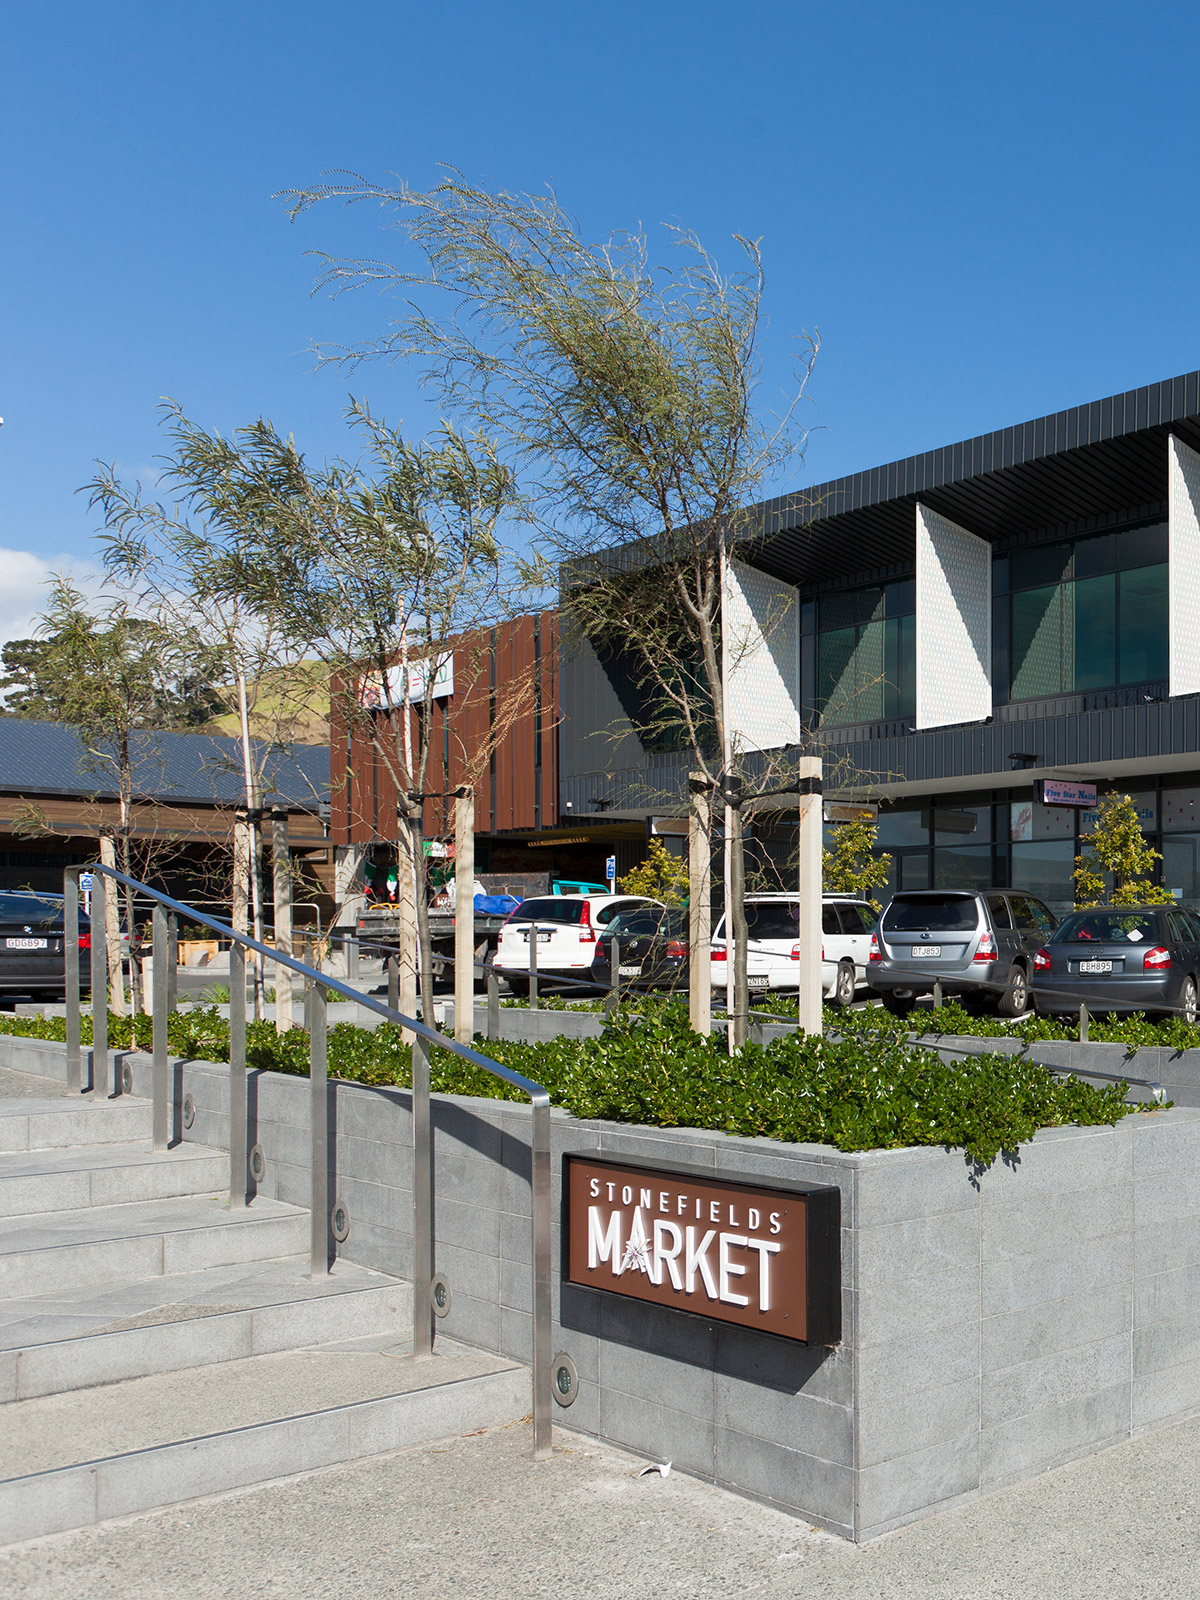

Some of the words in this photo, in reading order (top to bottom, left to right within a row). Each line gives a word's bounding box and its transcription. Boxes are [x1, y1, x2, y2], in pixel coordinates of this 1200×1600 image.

[1046, 789, 1061, 798] Five
[1063, 791, 1076, 799] Star
[1078, 790, 1096, 801] Nails
[913, 947, 940, 955] DTJ853
[1081, 962, 1111, 971] EBH895
[590, 1178, 781, 1234] STONEFIELDS
[588, 1205, 781, 1311] MARKET
